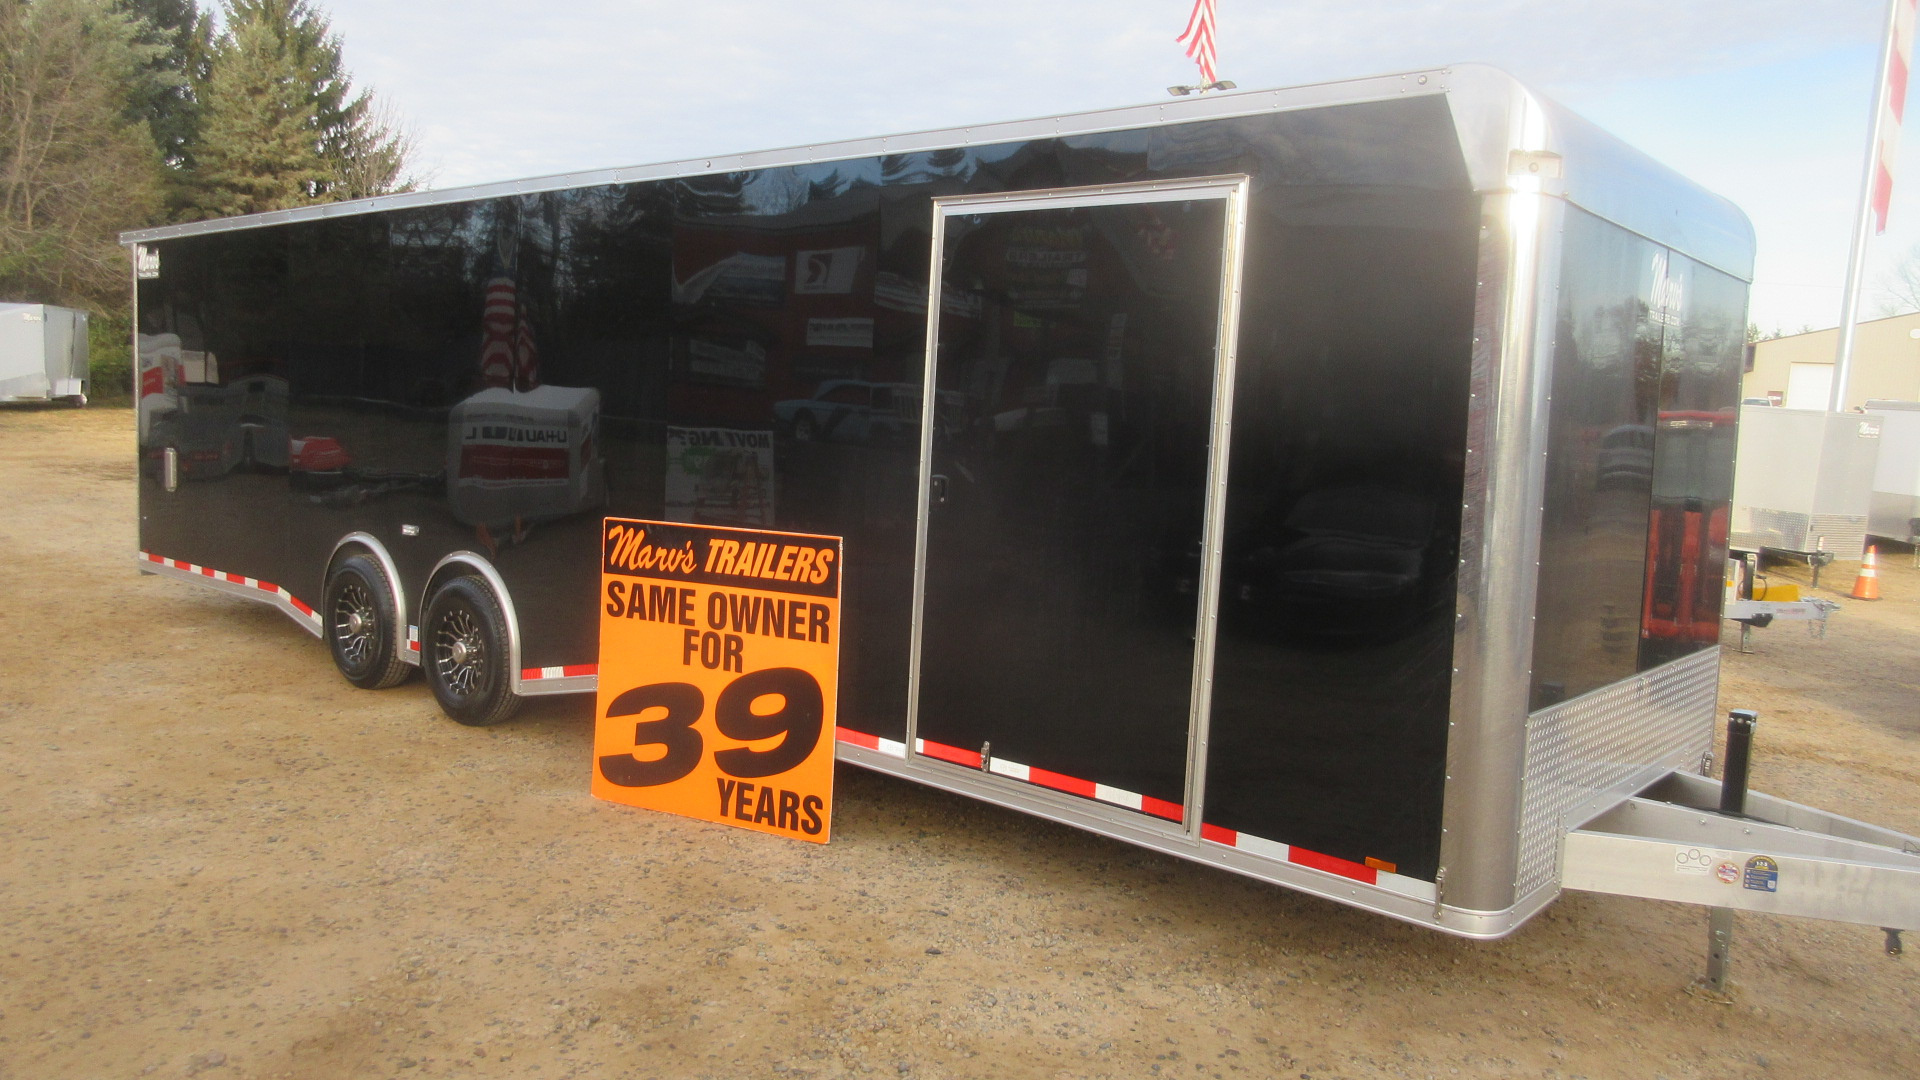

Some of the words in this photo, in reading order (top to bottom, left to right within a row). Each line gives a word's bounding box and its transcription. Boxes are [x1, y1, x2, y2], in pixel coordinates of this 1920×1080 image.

[608, 525, 697, 575] Marv's
[704, 538, 834, 585] TRAILERS
[606, 580, 696, 626] SAME
[707, 591, 831, 644] OWNER
[683, 629, 744, 673] FOR
[598, 667, 824, 787] 39
[716, 778, 823, 835] YEARS
